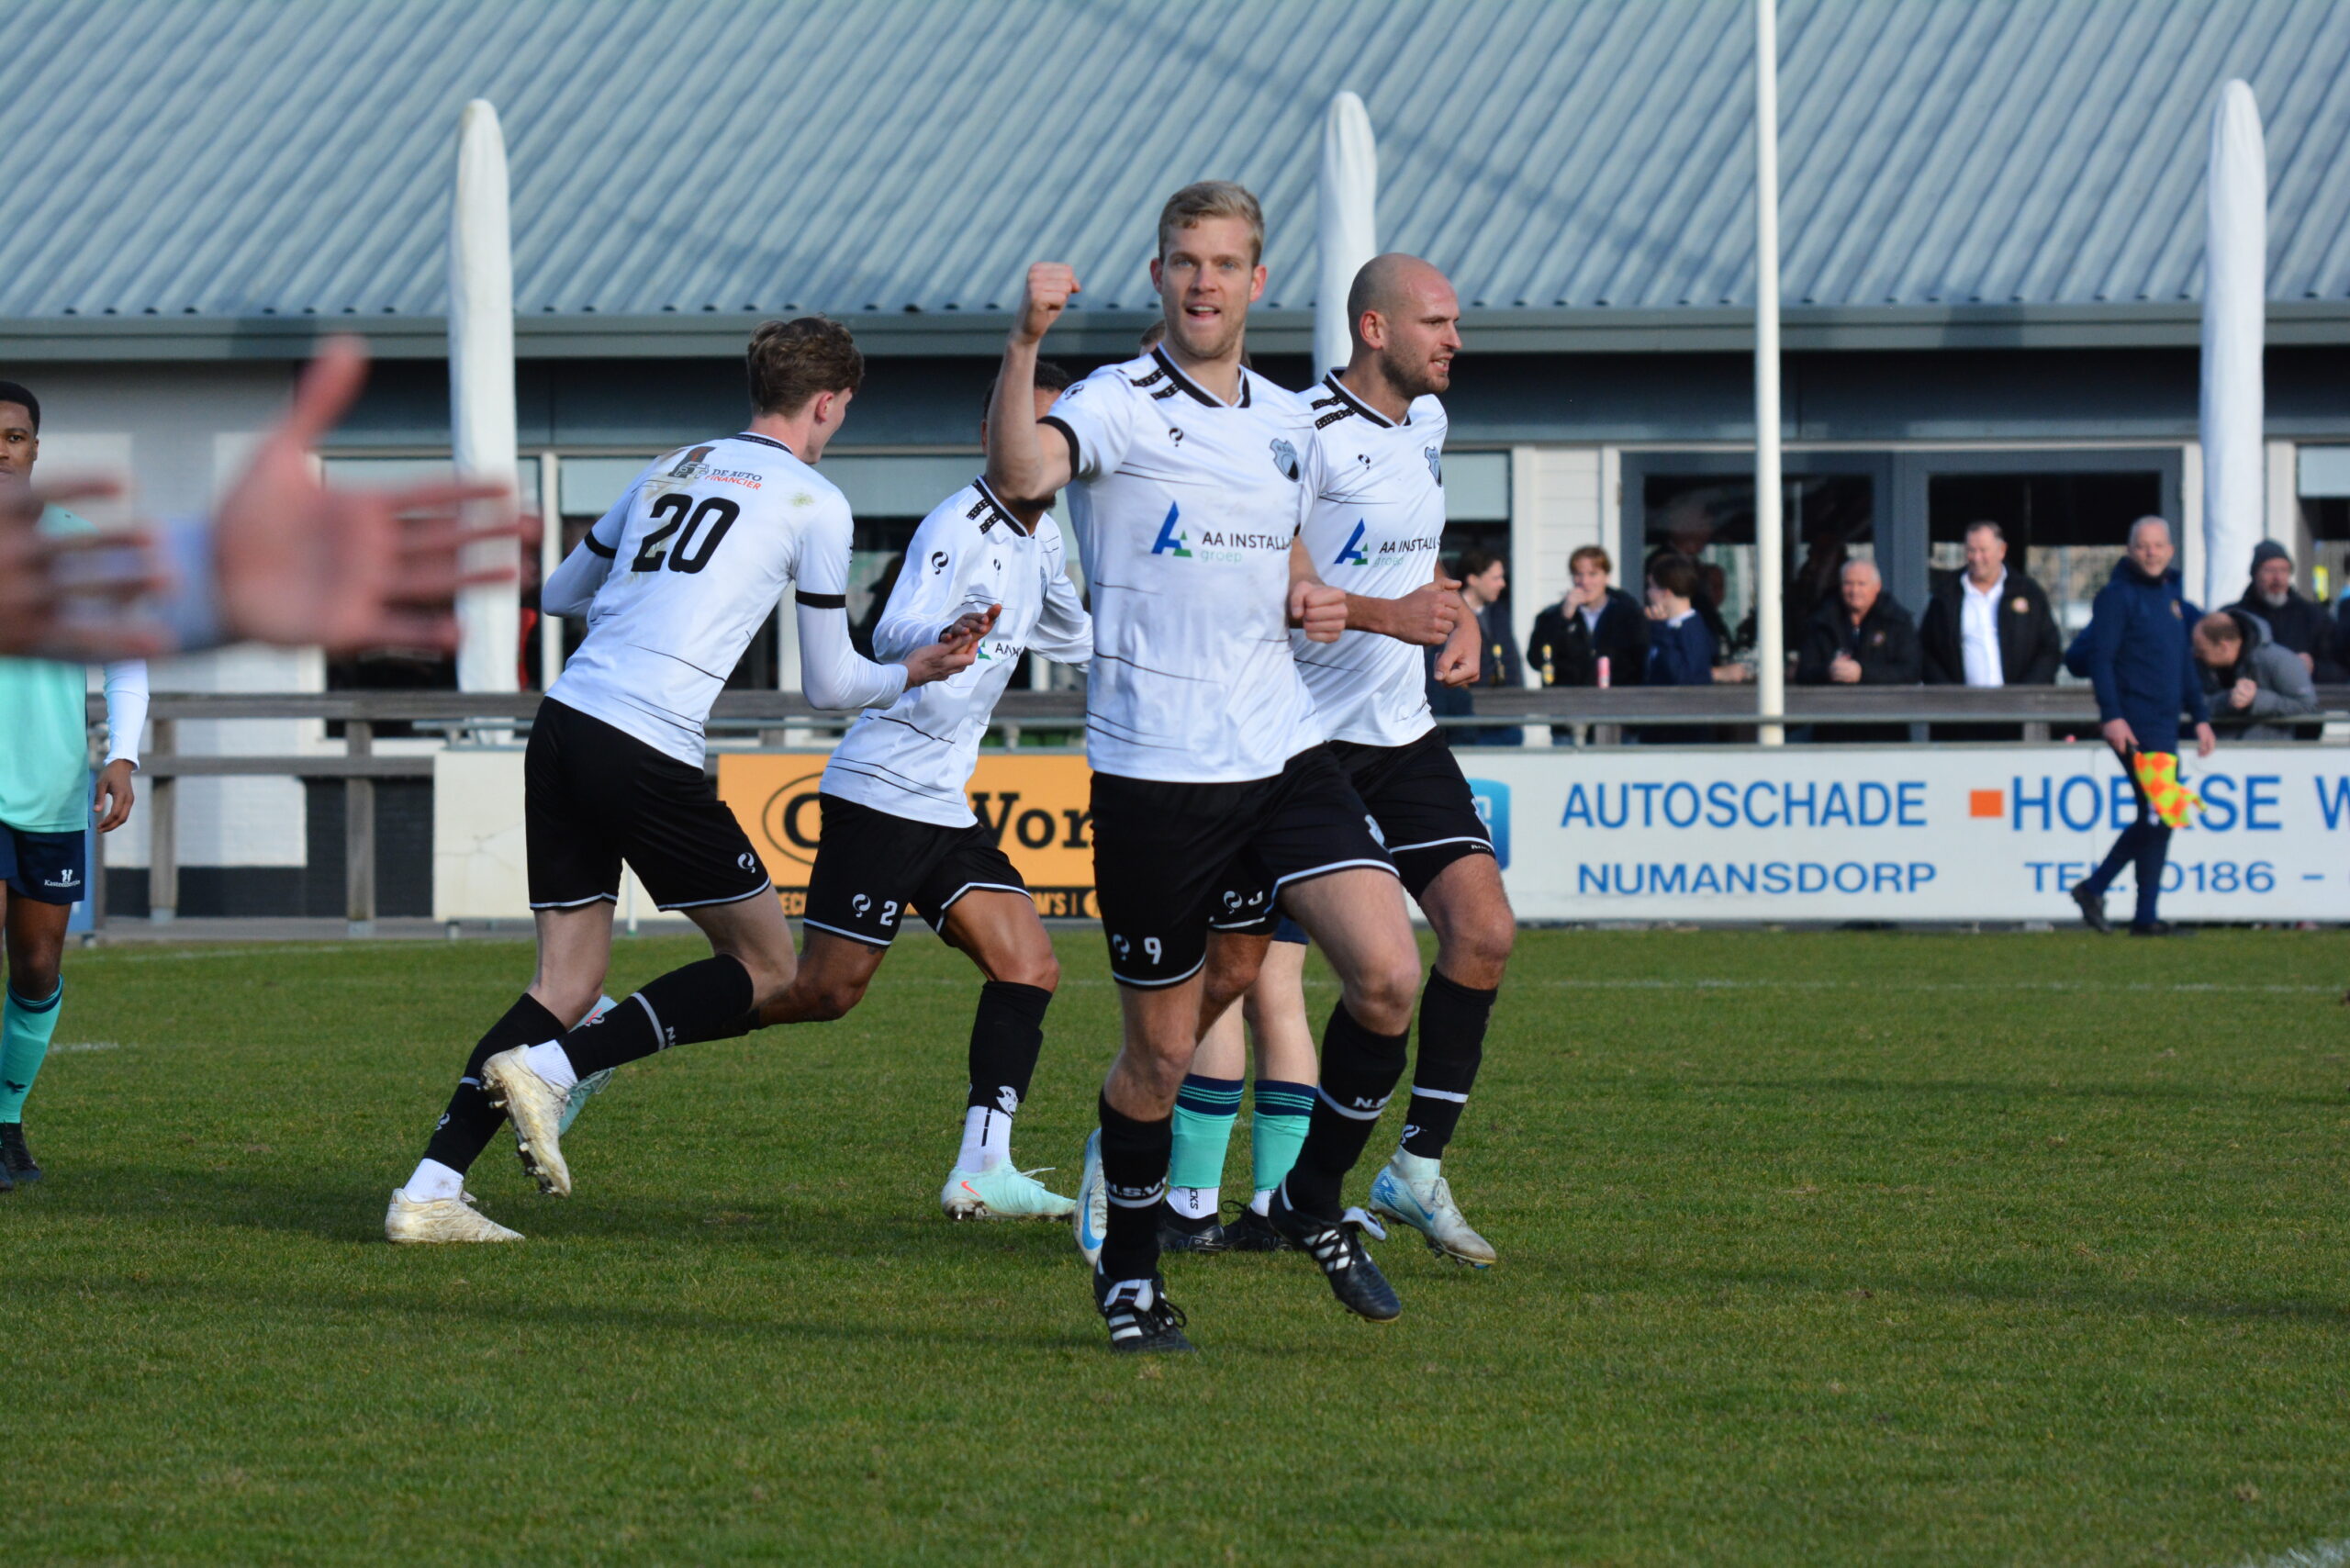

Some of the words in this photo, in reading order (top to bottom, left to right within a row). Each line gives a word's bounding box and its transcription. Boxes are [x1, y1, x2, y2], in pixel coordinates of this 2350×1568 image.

[704, 475, 762, 490] FINANCIER
[711, 468, 729, 476] DE
[729, 471, 763, 482] AUTO
[631, 492, 741, 574] 20
[1202, 532, 1225, 546] AA
[1200, 550, 1242, 564] groep
[1379, 541, 1396, 554] AA
[1561, 780, 1928, 828] AUTOSCHADE
[1578, 861, 1937, 894] NUMANSDORP
[2157, 861, 2276, 893] 0186
[879, 901, 898, 926] 2
[1144, 936, 1162, 965] 9
